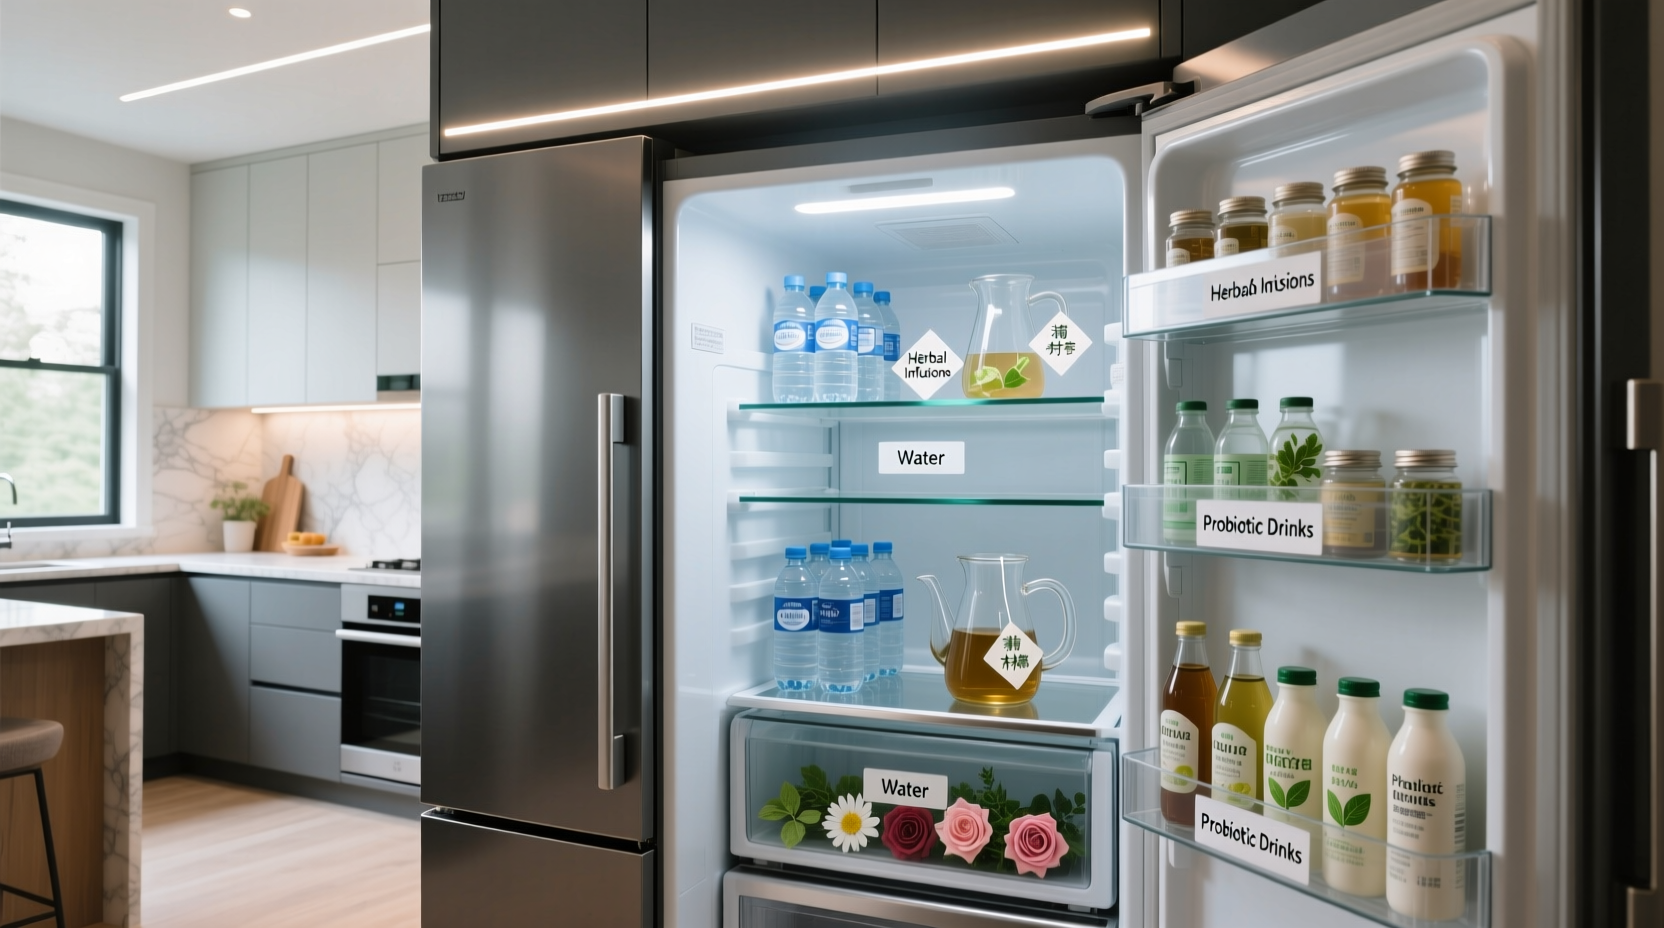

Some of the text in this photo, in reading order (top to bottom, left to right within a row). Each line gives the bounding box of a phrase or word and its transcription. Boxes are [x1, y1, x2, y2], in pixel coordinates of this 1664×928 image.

[908, 350, 947, 365] Herbal
[897, 449, 946, 466] Water
[1203, 514, 1314, 539] Probiotic Drinks
[881, 777, 930, 799] Water
[1201, 812, 1257, 848] Probiotic
[1259, 832, 1302, 865] Drinks
